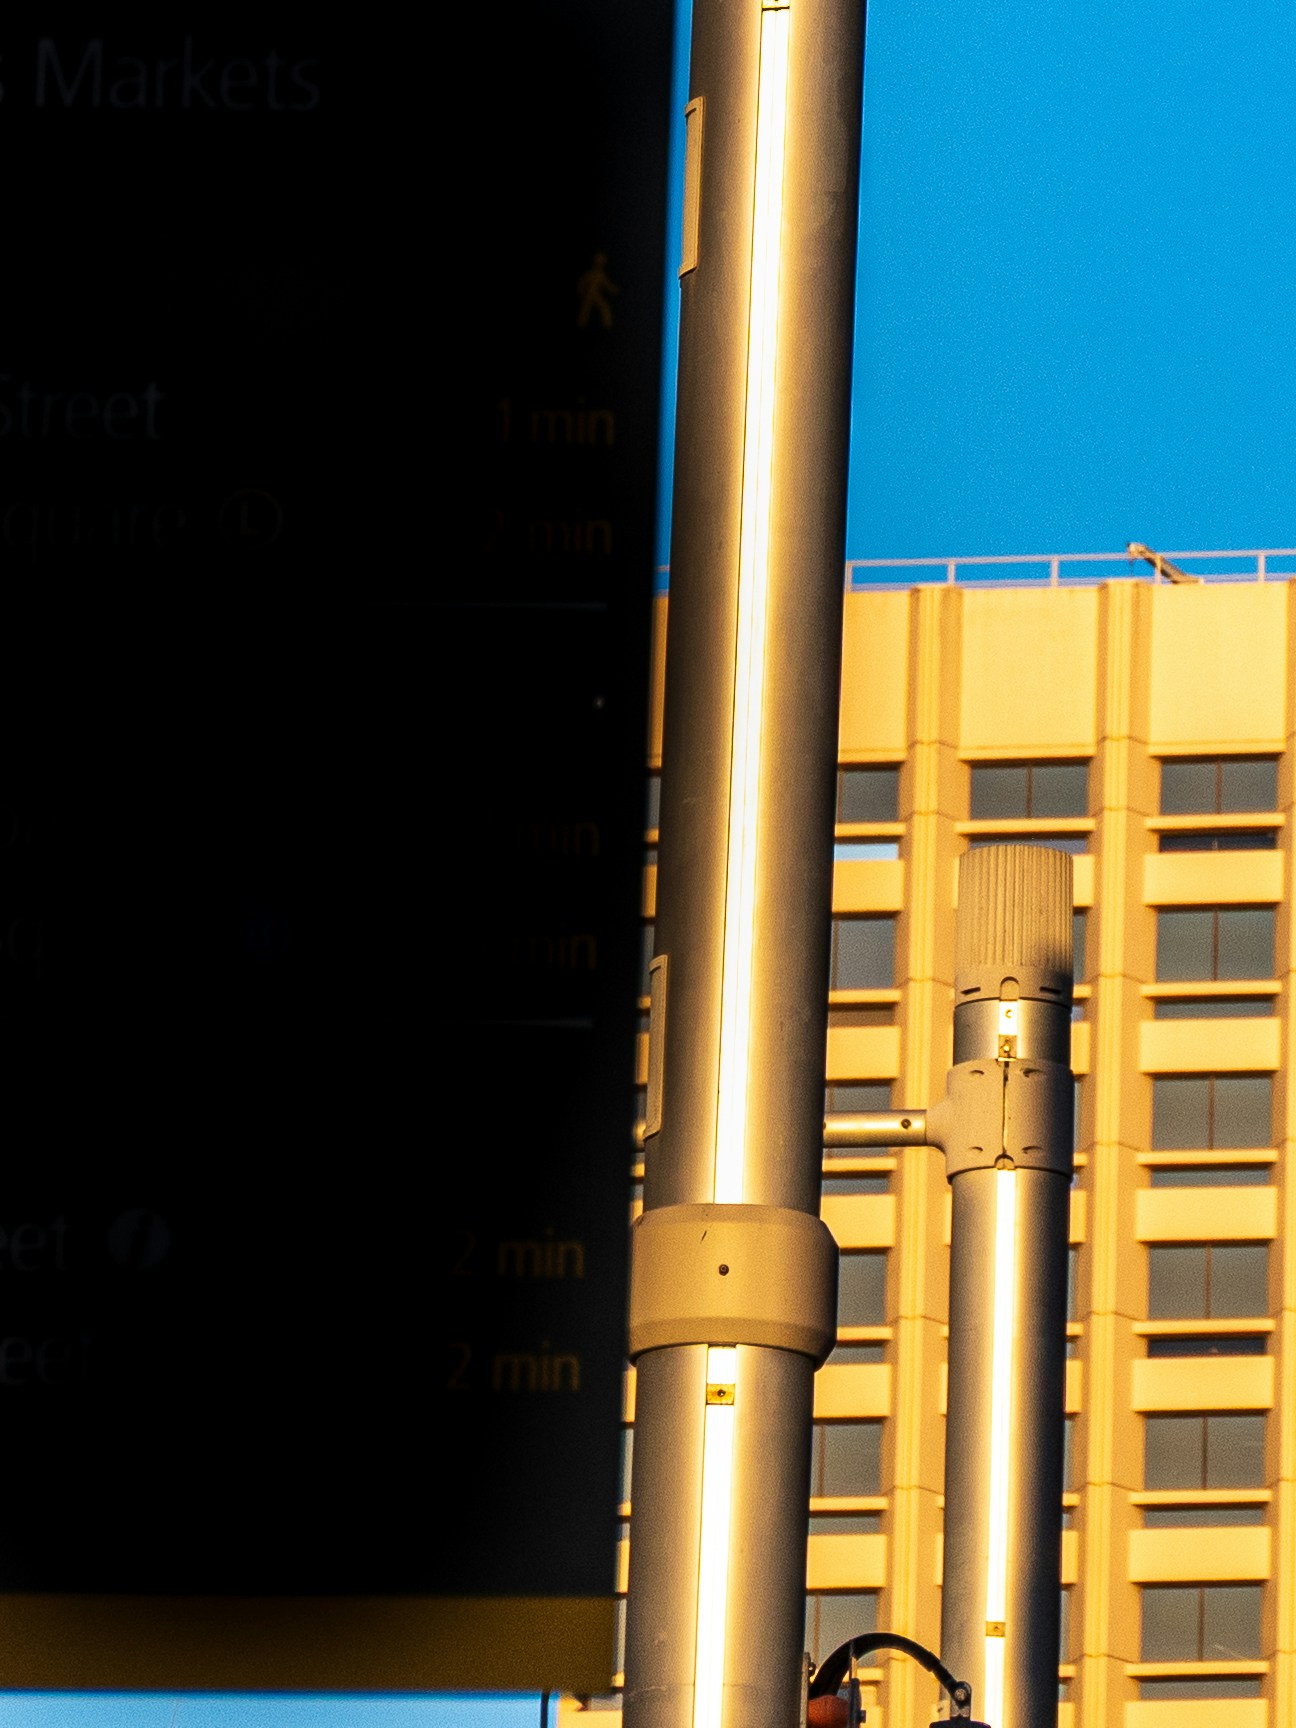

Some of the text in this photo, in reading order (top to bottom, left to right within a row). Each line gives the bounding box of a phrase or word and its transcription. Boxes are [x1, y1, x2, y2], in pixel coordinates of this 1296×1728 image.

[32, 31, 323, 112] Markets
[527, 394, 617, 448] min
[526, 505, 616, 557] min
[448, 1225, 586, 1280] 2 min
[446, 1336, 582, 1393] 2 min
